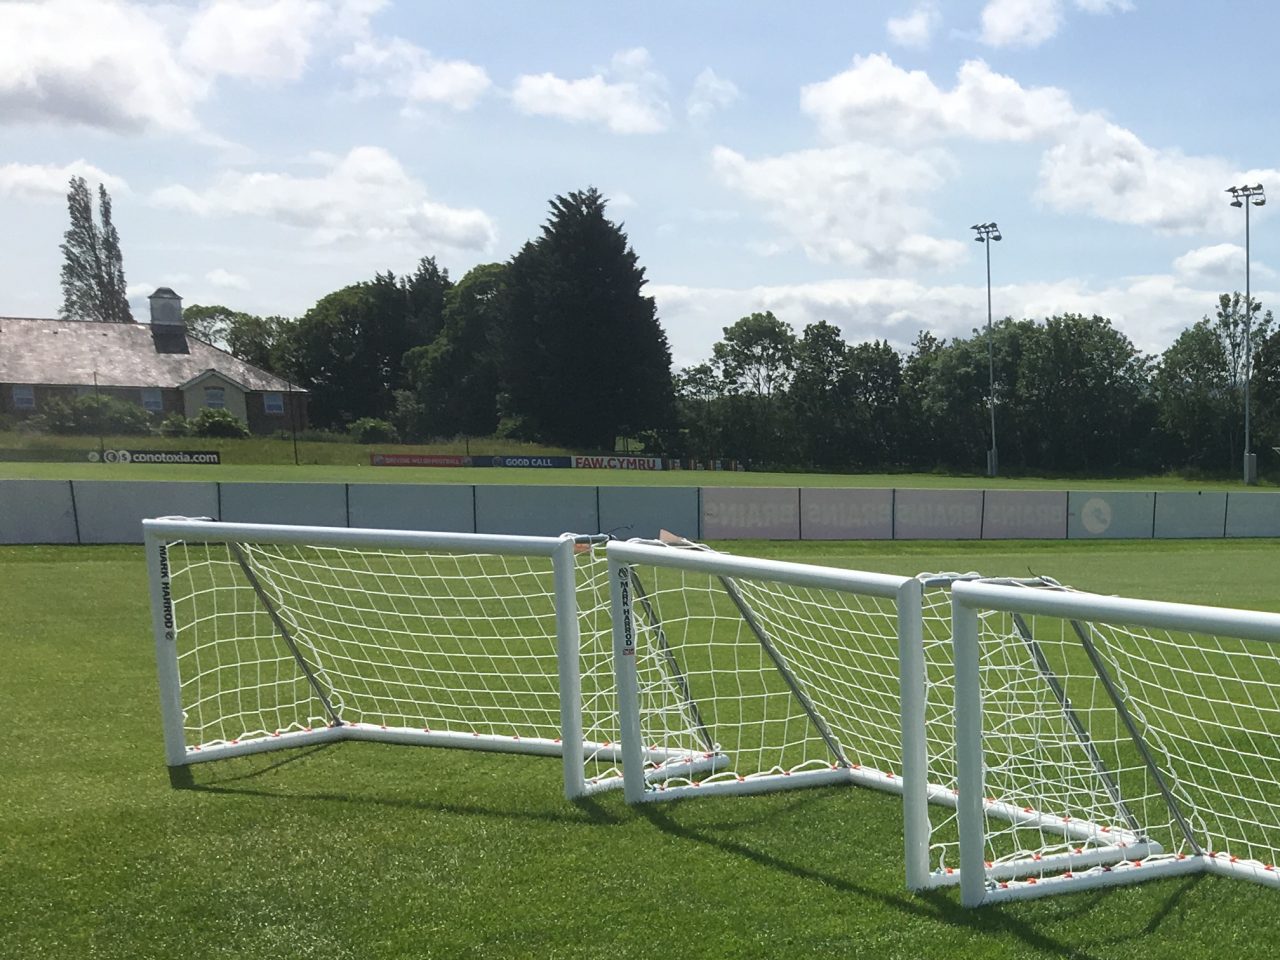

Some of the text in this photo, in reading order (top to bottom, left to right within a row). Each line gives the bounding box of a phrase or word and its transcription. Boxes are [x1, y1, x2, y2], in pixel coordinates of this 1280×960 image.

[133, 451, 218, 464] conotoxia.com
[505, 457, 553, 467] GOOD CALL
[575, 456, 656, 470] FAW.CYMRU
[160, 545, 173, 629] MARK HARROD
[620, 581, 632, 646] MARK HARROD
